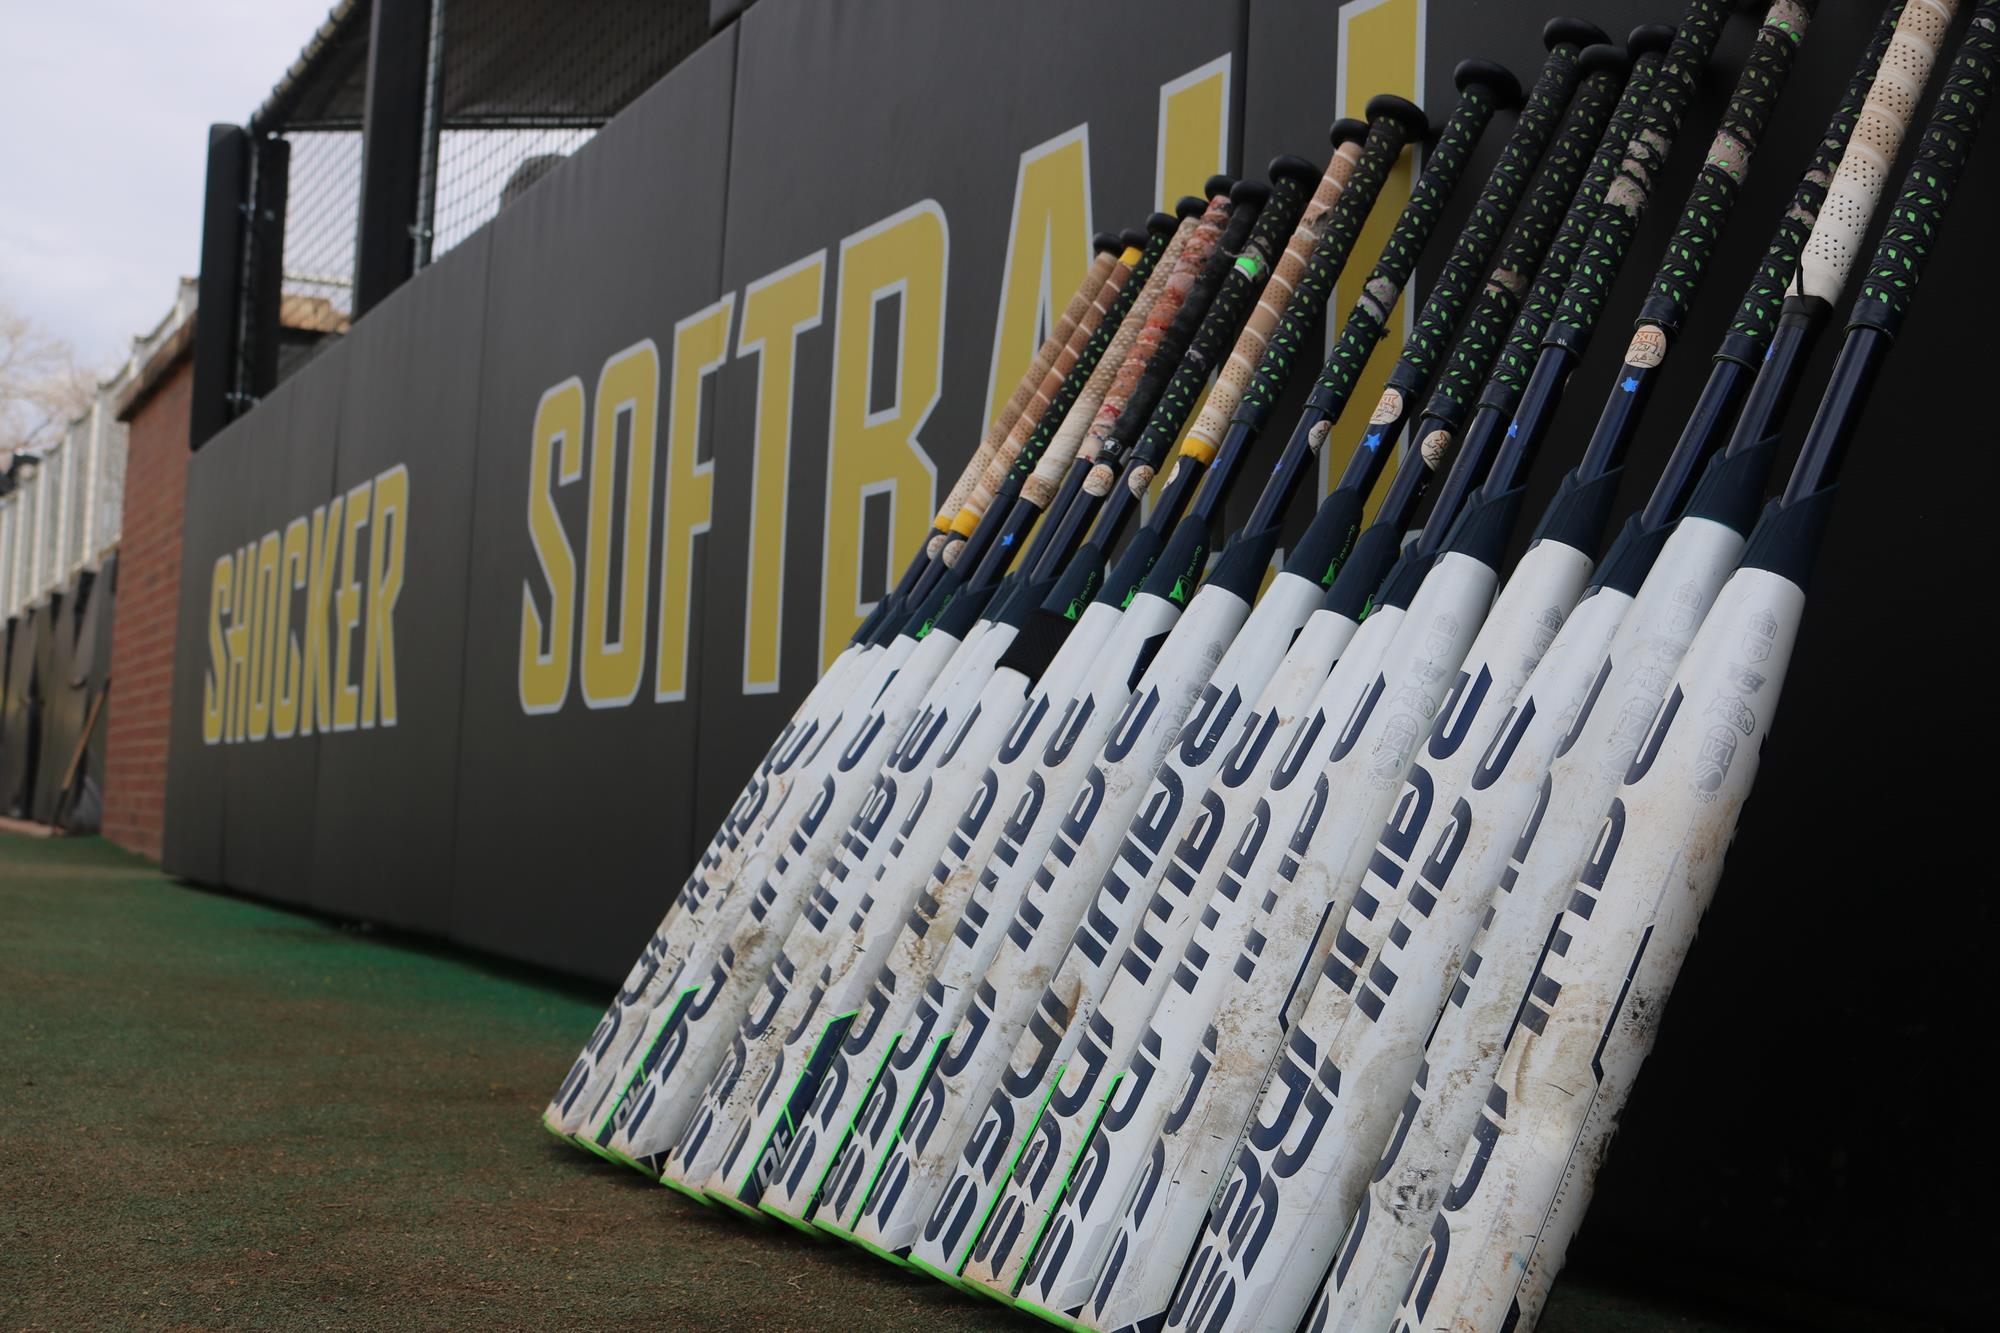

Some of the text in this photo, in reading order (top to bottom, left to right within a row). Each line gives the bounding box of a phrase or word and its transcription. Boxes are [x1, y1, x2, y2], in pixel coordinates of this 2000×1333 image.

[204, 463, 409, 744] SHOCKER
[1078, 570, 1097, 600] QUATRO
[1185, 544, 1202, 577] QUATRO
[925, 684, 1241, 1261] RAWLINGS
[976, 706, 1279, 1279] RAWLINGS
[1168, 659, 1492, 1327] RAWLINGS
[1390, 683, 1683, 1333] RAWLING
[752, 1132, 788, 1189] -10
[1545, 1164, 1575, 1229] SOFTBALL
[1575, 1093, 1604, 1154] OFFICIAL
